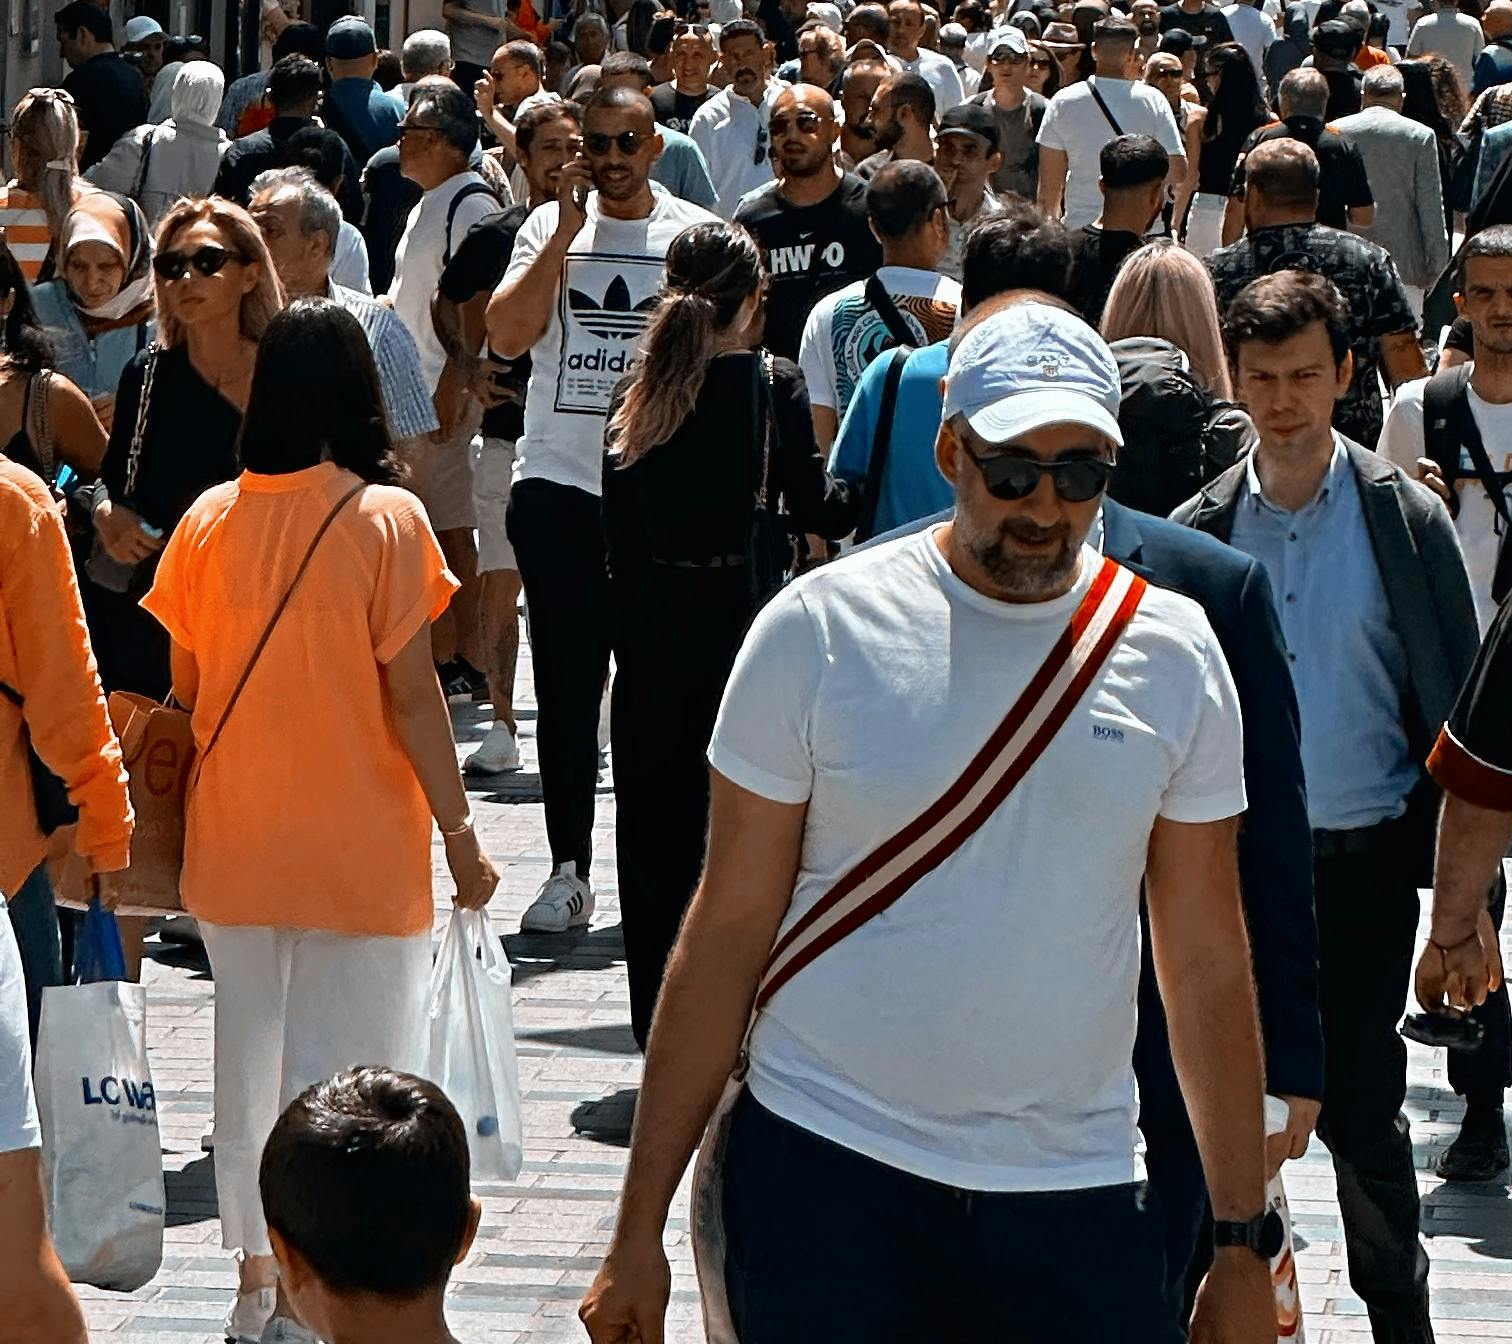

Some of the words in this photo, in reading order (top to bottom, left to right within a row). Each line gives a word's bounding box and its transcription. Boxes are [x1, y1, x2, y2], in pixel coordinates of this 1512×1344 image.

[770, 241, 844, 275] HWO
[568, 348, 645, 373] adid
[1093, 724, 1125, 739] BOSS
[82, 1076, 121, 1106] LC
